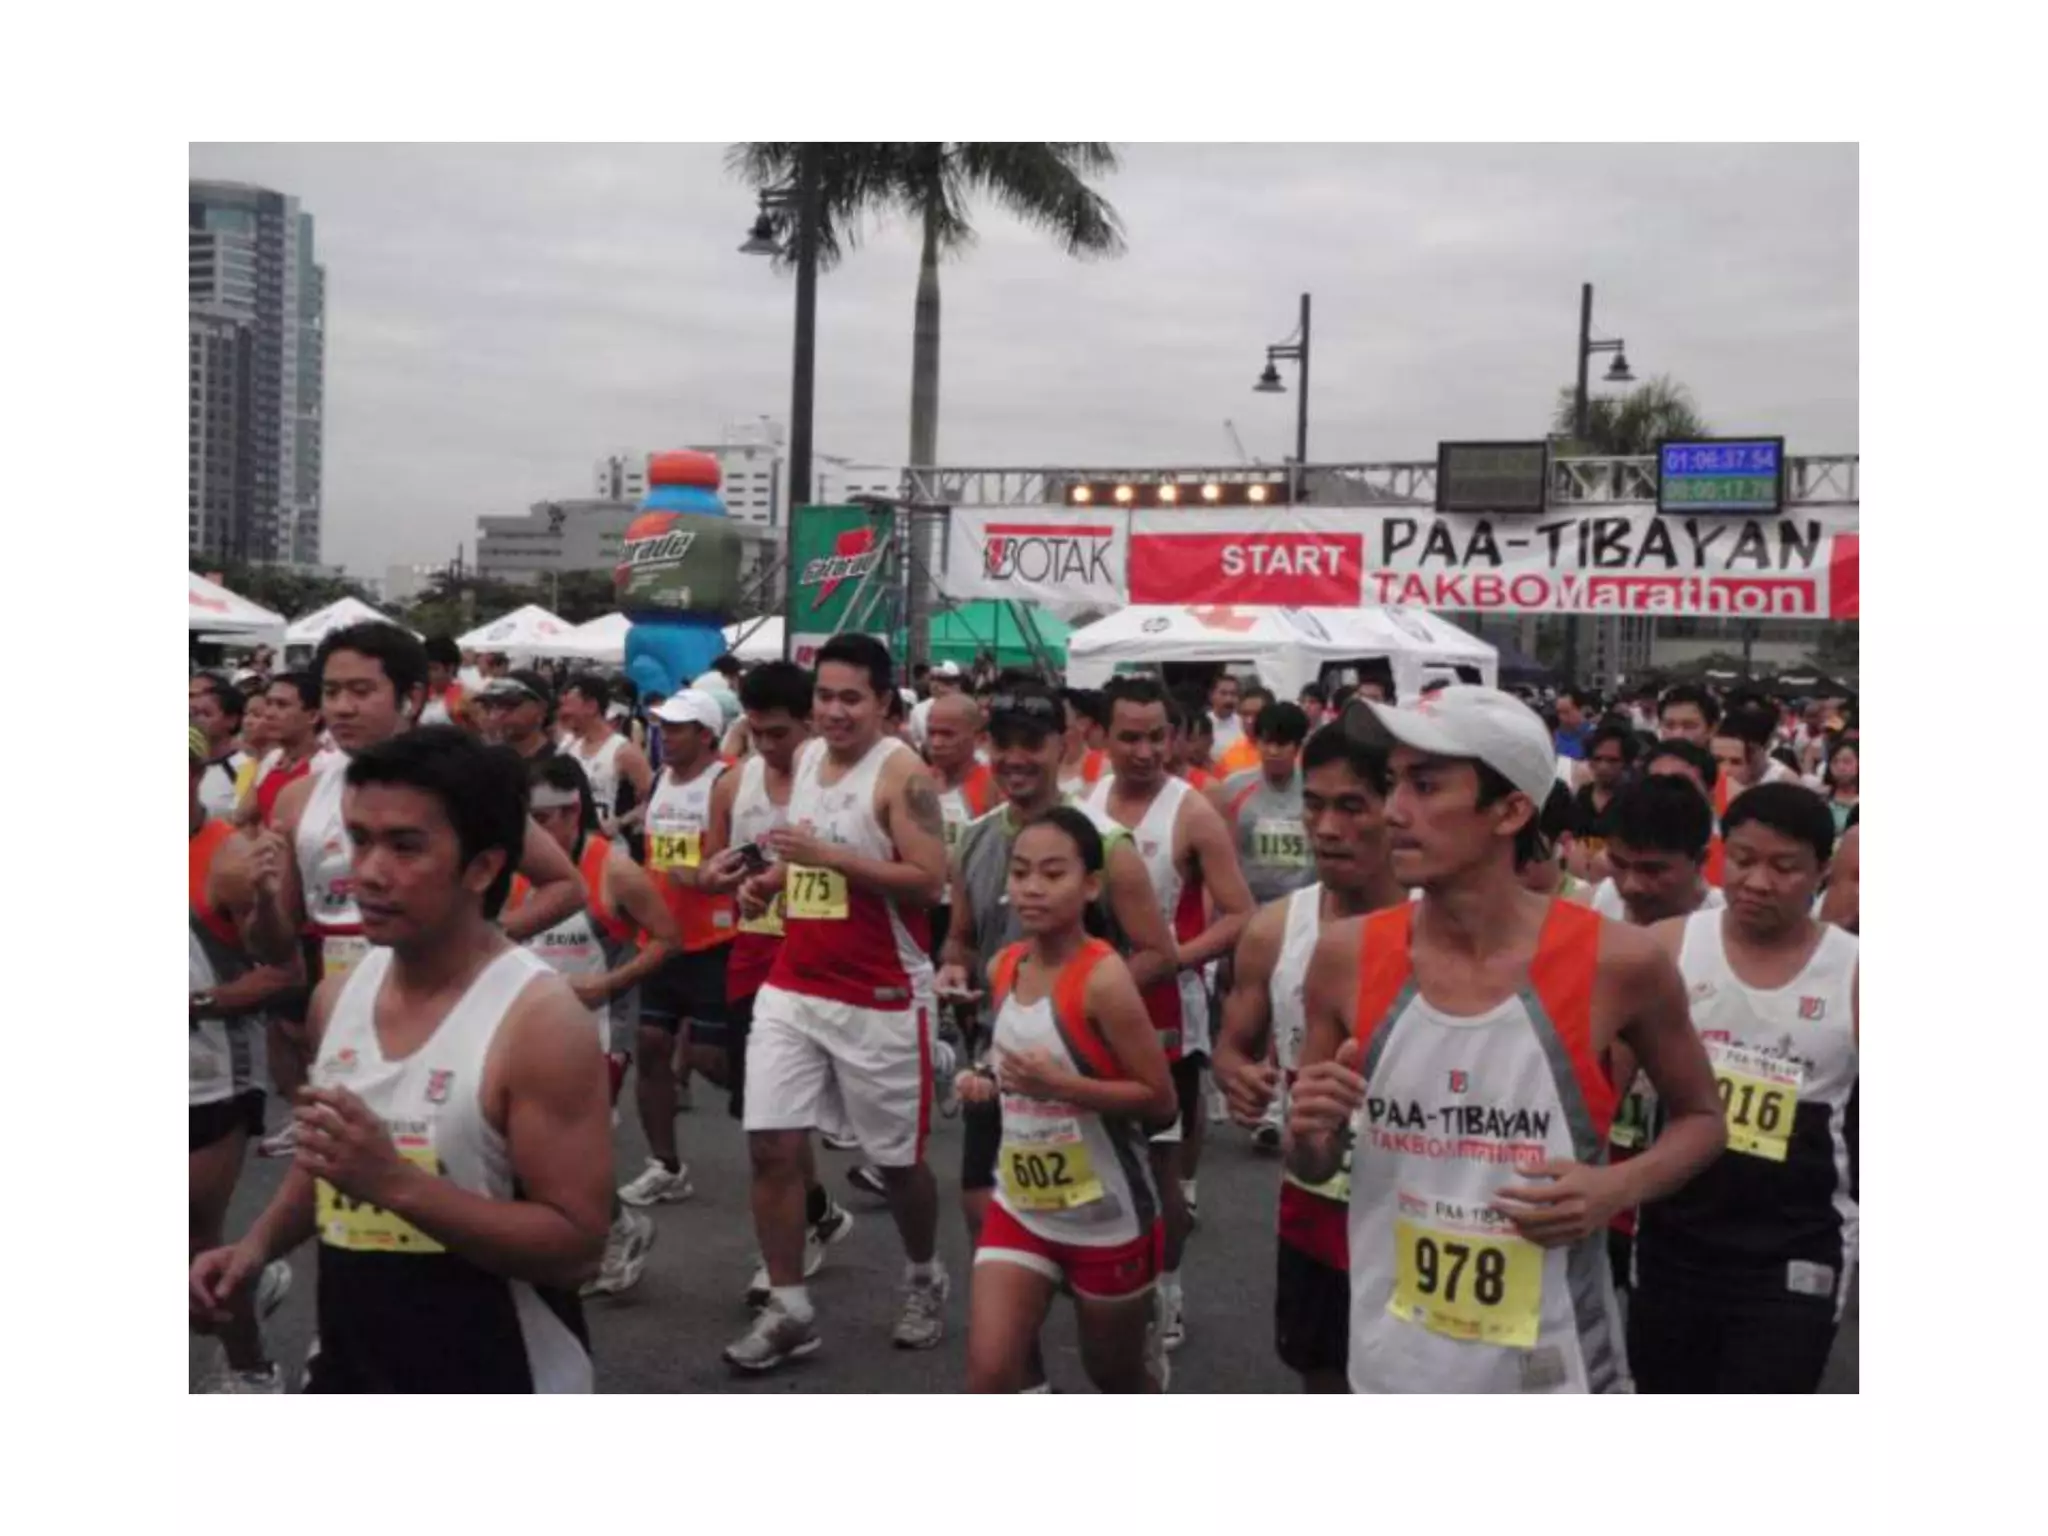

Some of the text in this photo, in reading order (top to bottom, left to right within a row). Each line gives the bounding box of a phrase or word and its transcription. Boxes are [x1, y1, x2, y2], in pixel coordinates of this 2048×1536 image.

[1221, 544, 1346, 577] START
[1382, 517, 1821, 569] PAA-TIBAYAN
[793, 872, 831, 902] 775
[1367, 1098, 1551, 1139] PAA-TIBAYAN
[1012, 1151, 1075, 1189] 602
[1414, 1236, 1506, 1306] 978
